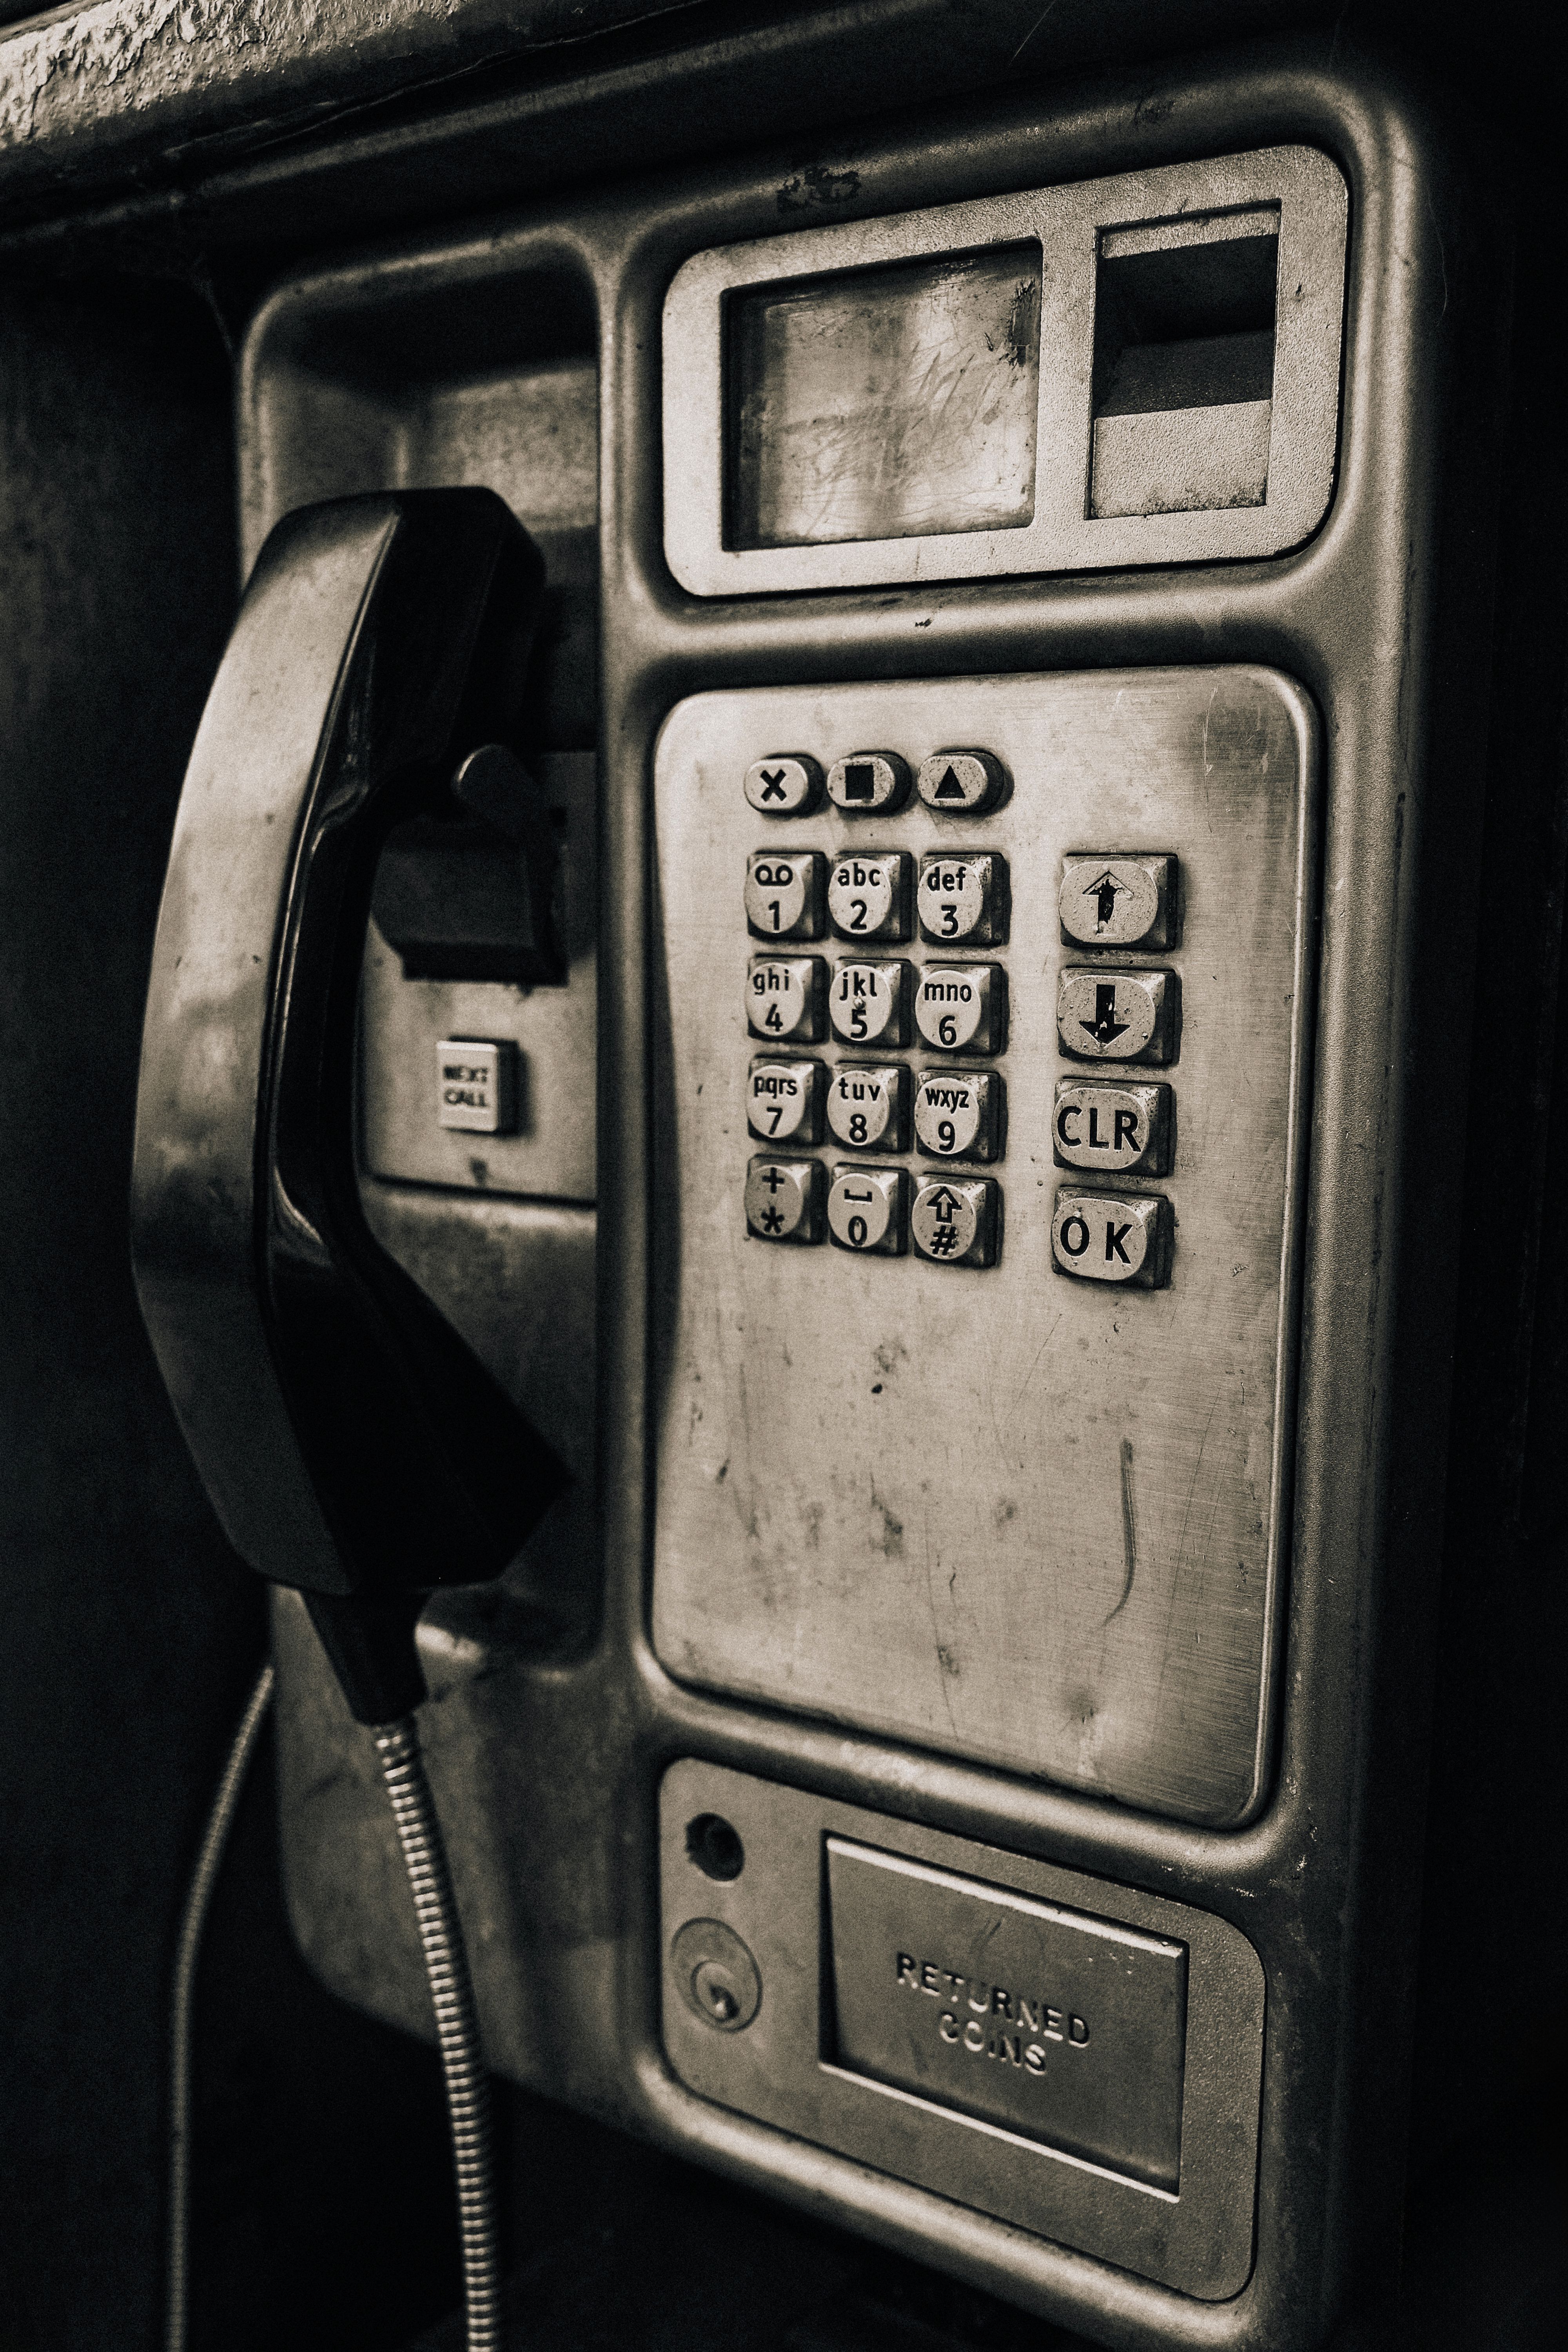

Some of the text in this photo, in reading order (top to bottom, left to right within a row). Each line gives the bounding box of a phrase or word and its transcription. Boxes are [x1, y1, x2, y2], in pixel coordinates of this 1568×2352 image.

[838, 862, 880, 886] abc
[927, 866, 966, 891] def
[769, 901, 780, 930] 1
[850, 899, 867, 930] 2
[941, 905, 958, 936] 3
[753, 968, 789, 995] ghi
[839, 971, 877, 1000] jkl
[924, 983, 971, 1002] mno
[765, 1004, 783, 1032] 4
[851, 1008, 867, 1038] 5
[939, 1015, 956, 1045] 6
[444, 1089, 488, 1107] CALL
[754, 1076, 797, 1099] pqrs
[838, 1078, 880, 1101] tuv
[925, 1088, 969, 1113] wxyz
[766, 1107, 783, 1135] 7
[849, 1114, 867, 1143] 8
[1057, 1106, 1141, 1152] CLR
[938, 1121, 955, 1152] 9
[848, 1216, 867, 1247] 0
[896, 1951, 1090, 2048] RETURNED
[940, 2011, 1045, 2076] COINS
